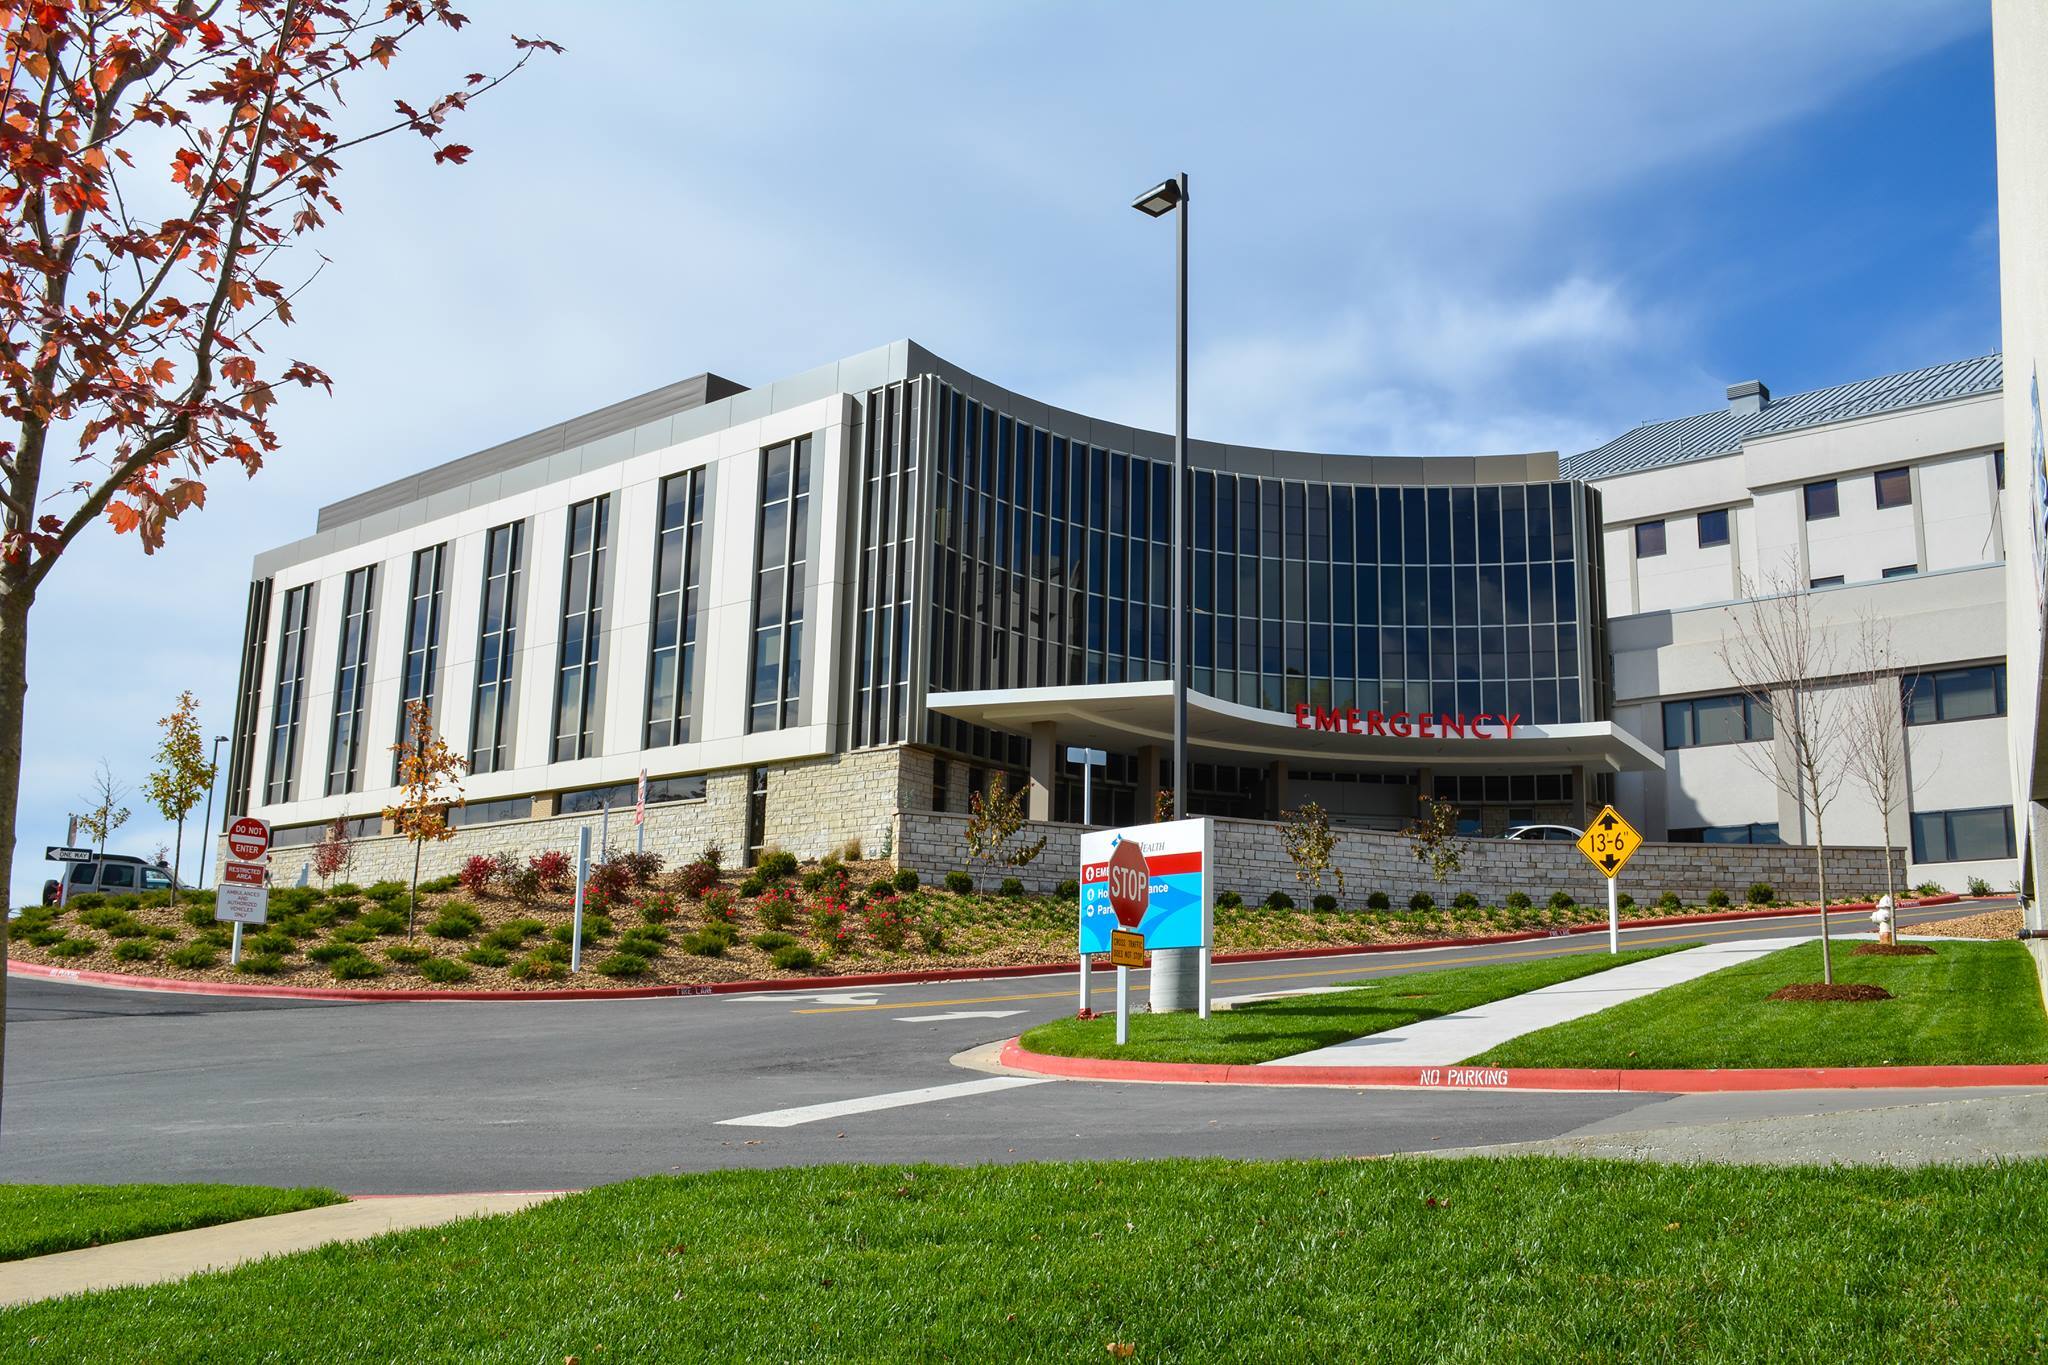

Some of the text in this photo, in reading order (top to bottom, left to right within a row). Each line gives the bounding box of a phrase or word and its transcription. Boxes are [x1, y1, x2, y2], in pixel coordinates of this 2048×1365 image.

[1295, 703, 1520, 740] EMERGENCY
[236, 825, 262, 835] DO NOT
[236, 844, 258, 854] ENTER
[1111, 865, 1147, 902] STOP
[1113, 938, 1143, 948] CROSS TRAFFIC
[1124, 951, 1132, 959] NOT
[676, 986, 713, 995] FIRE LANE
[1420, 1069, 1509, 1086] NO PARKING
